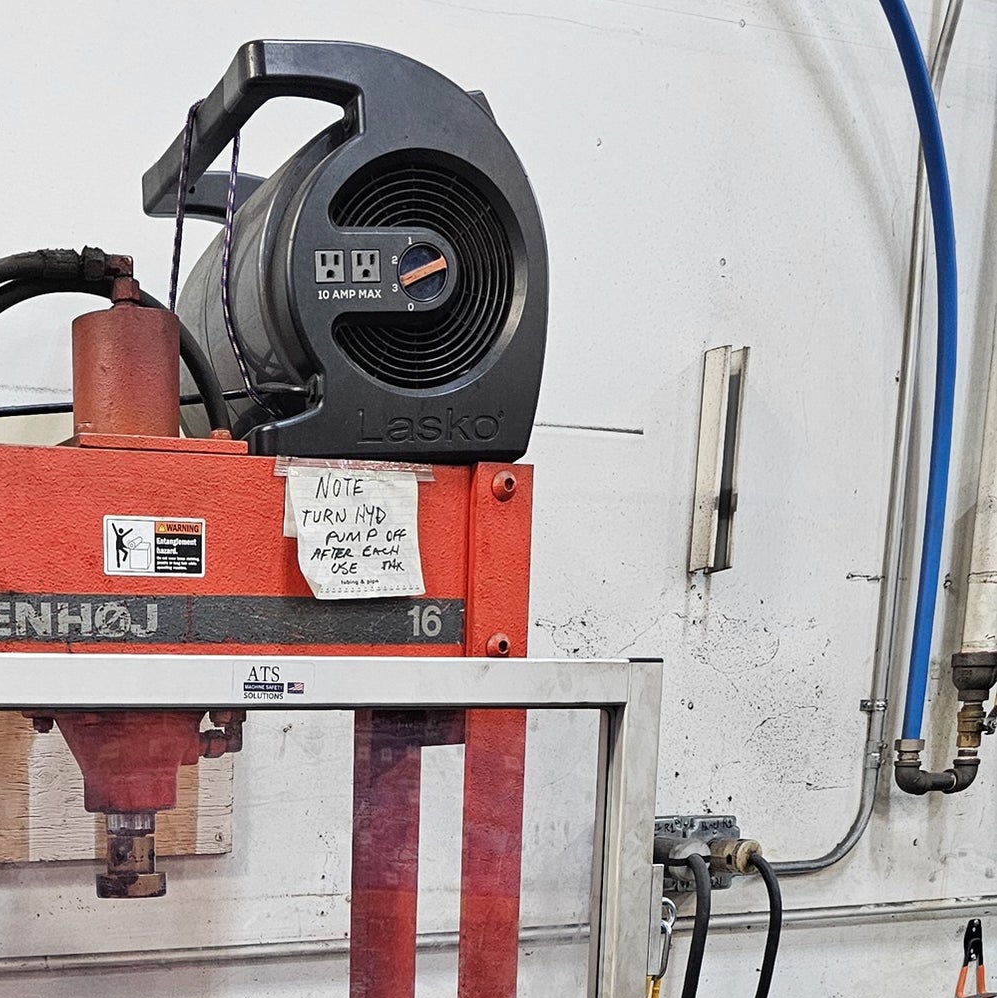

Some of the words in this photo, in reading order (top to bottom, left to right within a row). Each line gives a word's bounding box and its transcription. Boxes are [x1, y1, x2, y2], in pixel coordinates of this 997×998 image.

[407, 237, 413, 245] 1
[391, 256, 398, 264] 2
[392, 284, 398, 292] 3
[317, 290, 330, 299] 10
[332, 290, 356, 299] AMP
[358, 289, 382, 298] MAX
[407, 303, 414, 311] 0
[356, 407, 500, 444] Lasko
[315, 472, 364, 499] NOTE
[302, 508, 347, 527] TURN
[355, 503, 387, 526] HYD
[166, 524, 199, 533] WARNING
[156, 537, 197, 546] Entanglement
[325, 528, 378, 546] PUMP
[386, 528, 407, 542] OFF
[156, 547, 178, 555] hazard.
[310, 546, 354, 560] AFTER
[362, 545, 399, 557] EACH
[331, 562, 358, 575] USE
[407, 605, 442, 637] 16
[247, 666, 280, 682] ATS
[244, 692, 284, 700] SOLUTIONS
